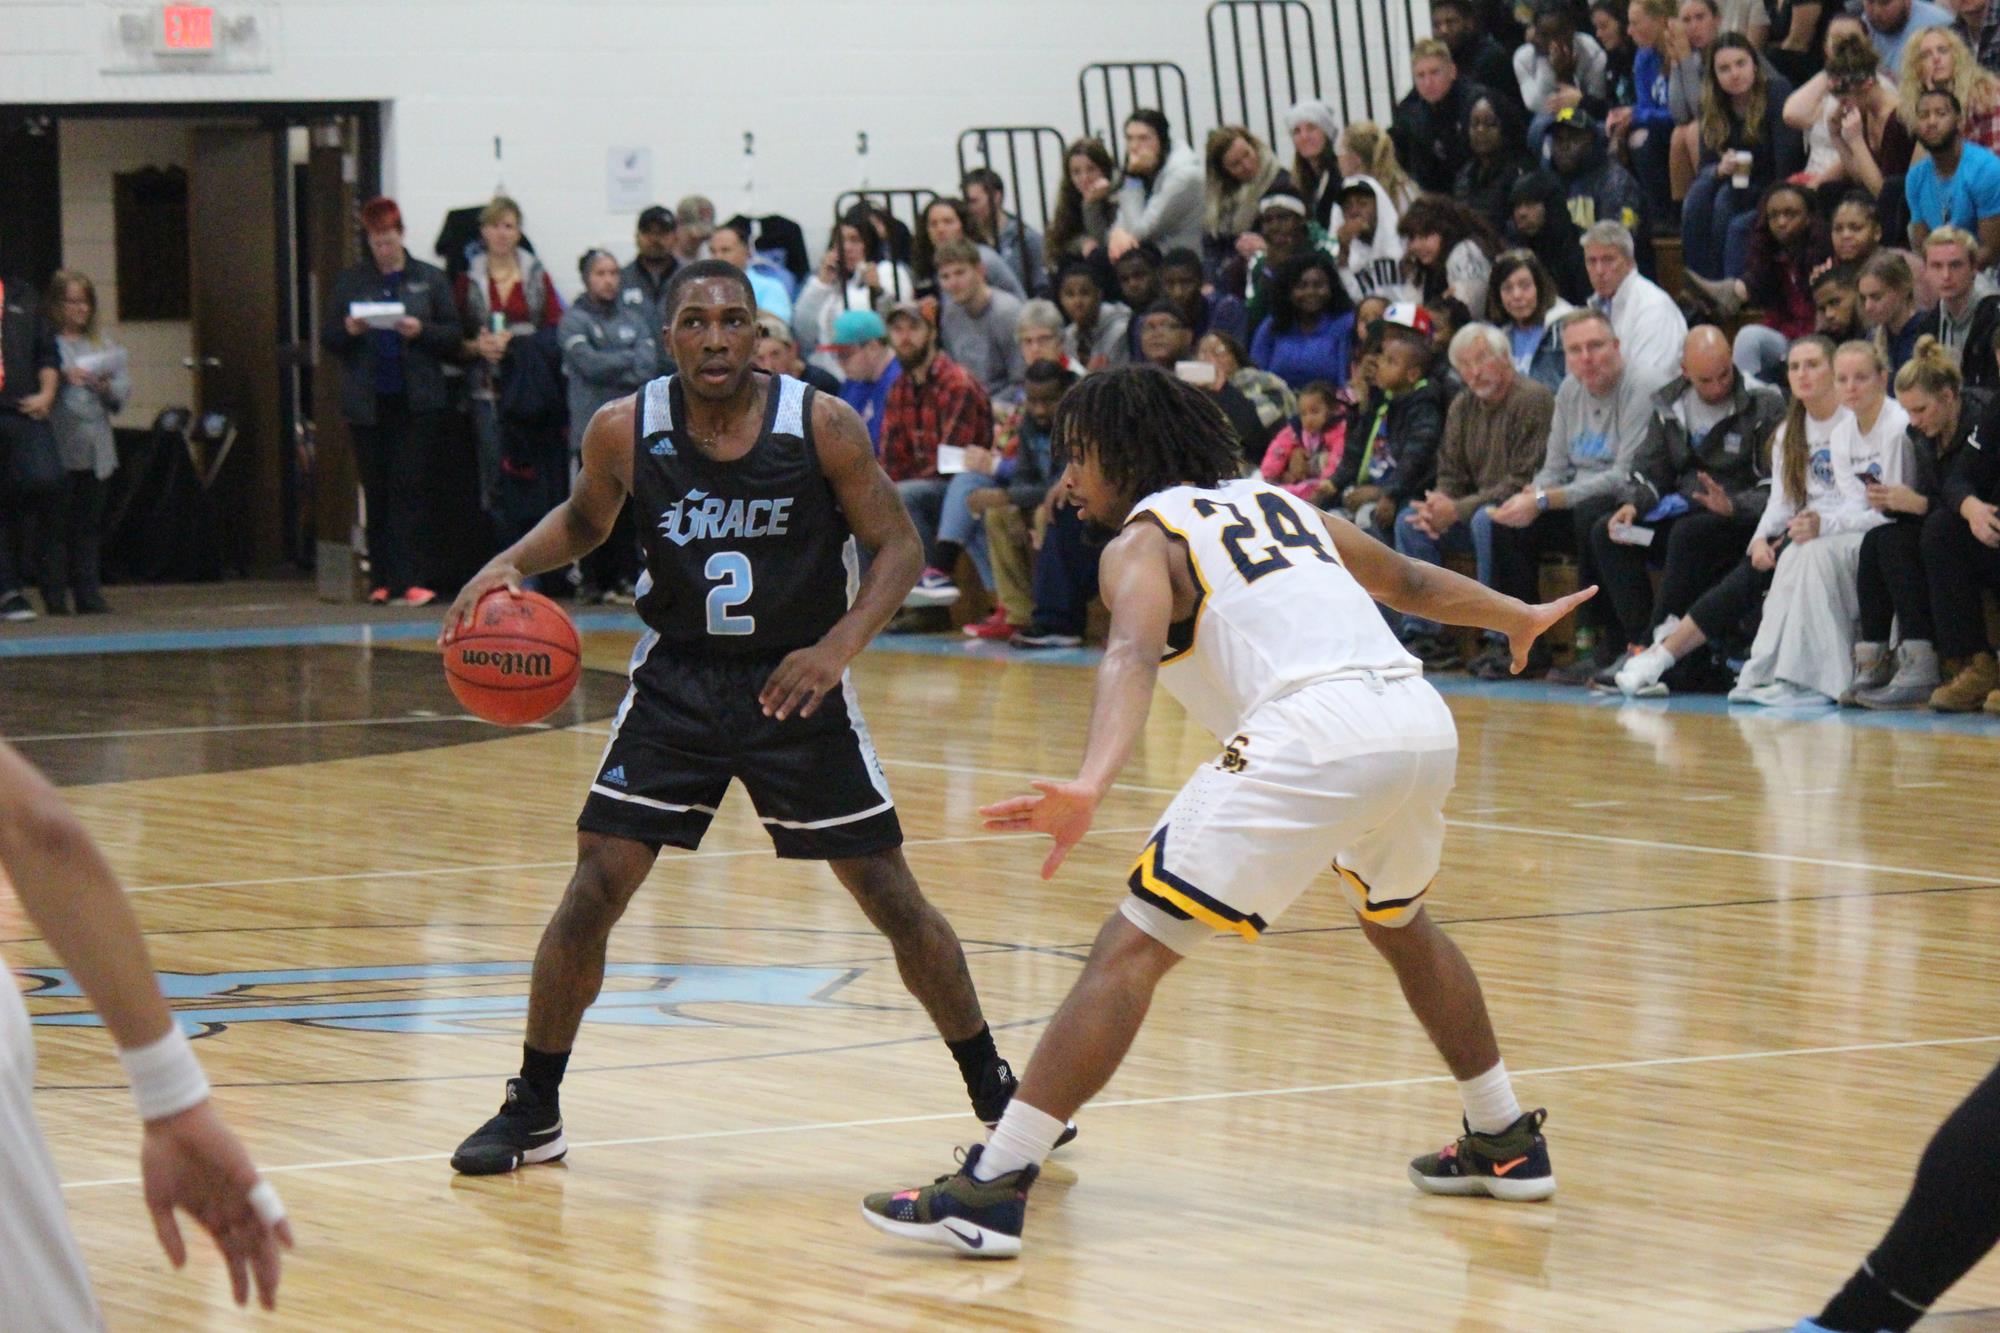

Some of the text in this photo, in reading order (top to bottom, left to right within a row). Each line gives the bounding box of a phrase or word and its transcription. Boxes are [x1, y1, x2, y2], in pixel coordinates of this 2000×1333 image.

[164, 6, 213, 48] EXIT
[657, 488, 794, 547] GRACE
[1192, 492, 1341, 585] 24
[703, 550, 756, 636] 2
[461, 649, 552, 677] Wilson
